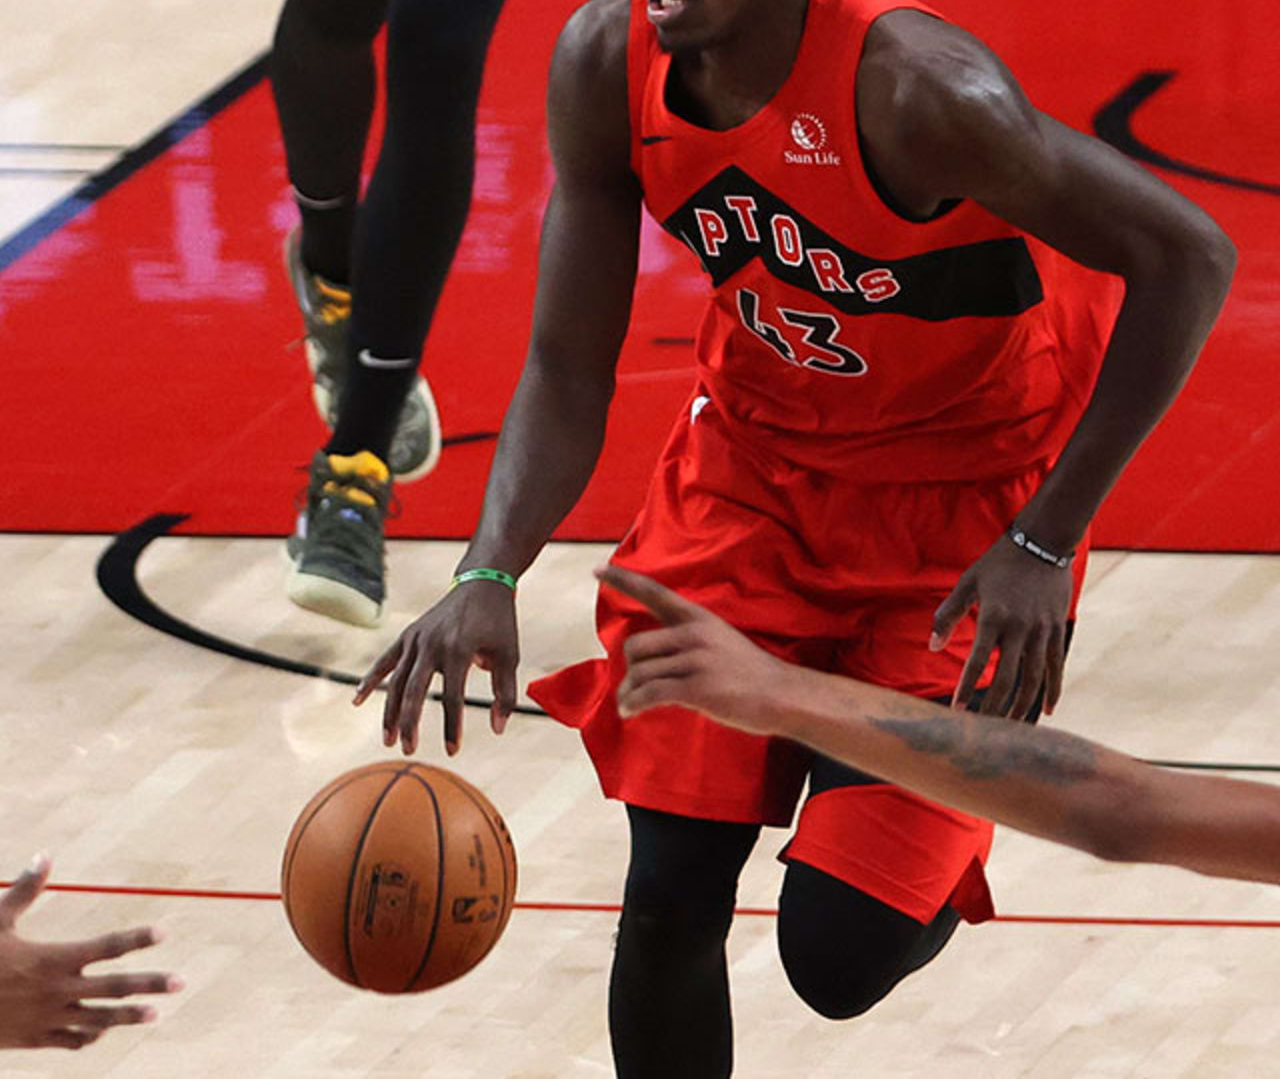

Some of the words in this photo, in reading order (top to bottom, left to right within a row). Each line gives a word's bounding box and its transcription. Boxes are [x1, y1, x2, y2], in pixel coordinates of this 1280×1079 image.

[783, 150, 813, 164] Sun
[814, 150, 841, 166] Life
[736, 287, 868, 377] 43
